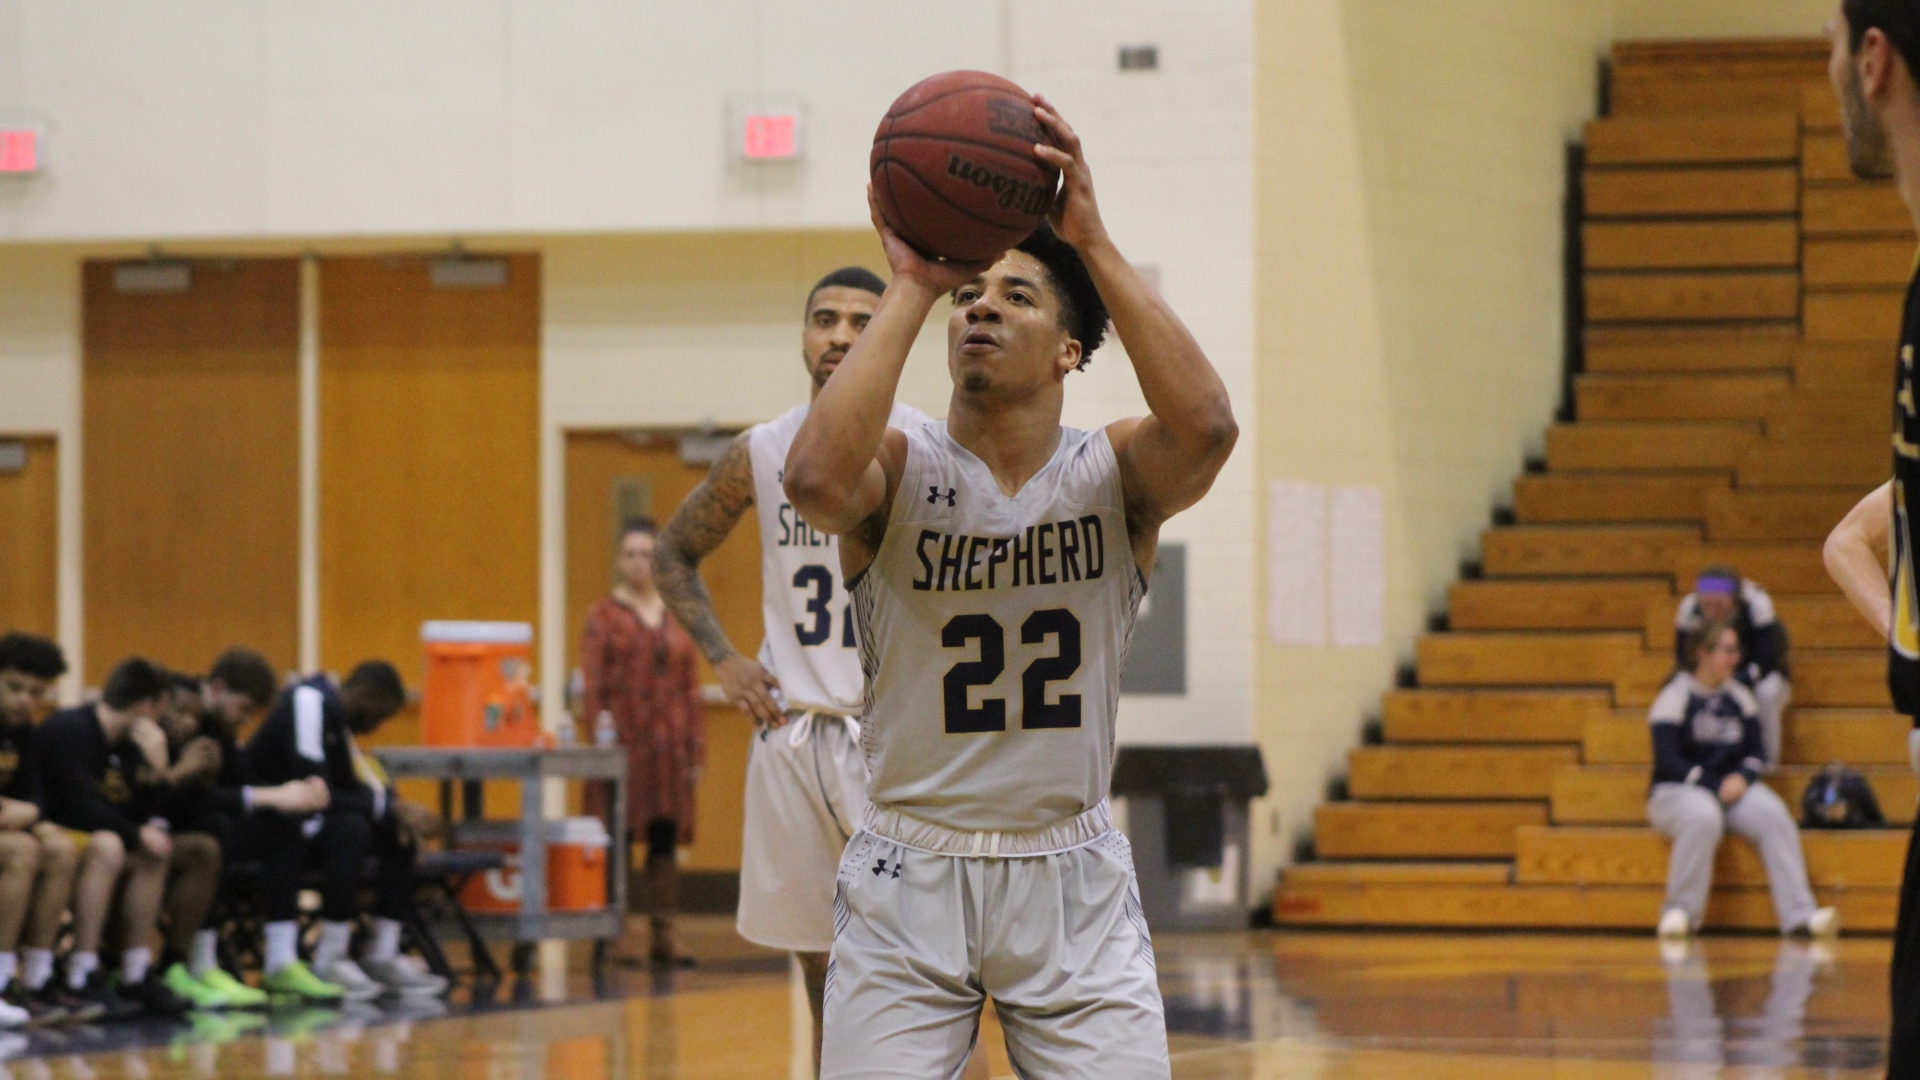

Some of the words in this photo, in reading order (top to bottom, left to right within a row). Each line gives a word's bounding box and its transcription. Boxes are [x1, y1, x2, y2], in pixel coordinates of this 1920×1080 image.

[947, 153, 1051, 217] Wilson
[912, 514, 1104, 591] SHEPHERD
[941, 607, 1082, 734] 22
